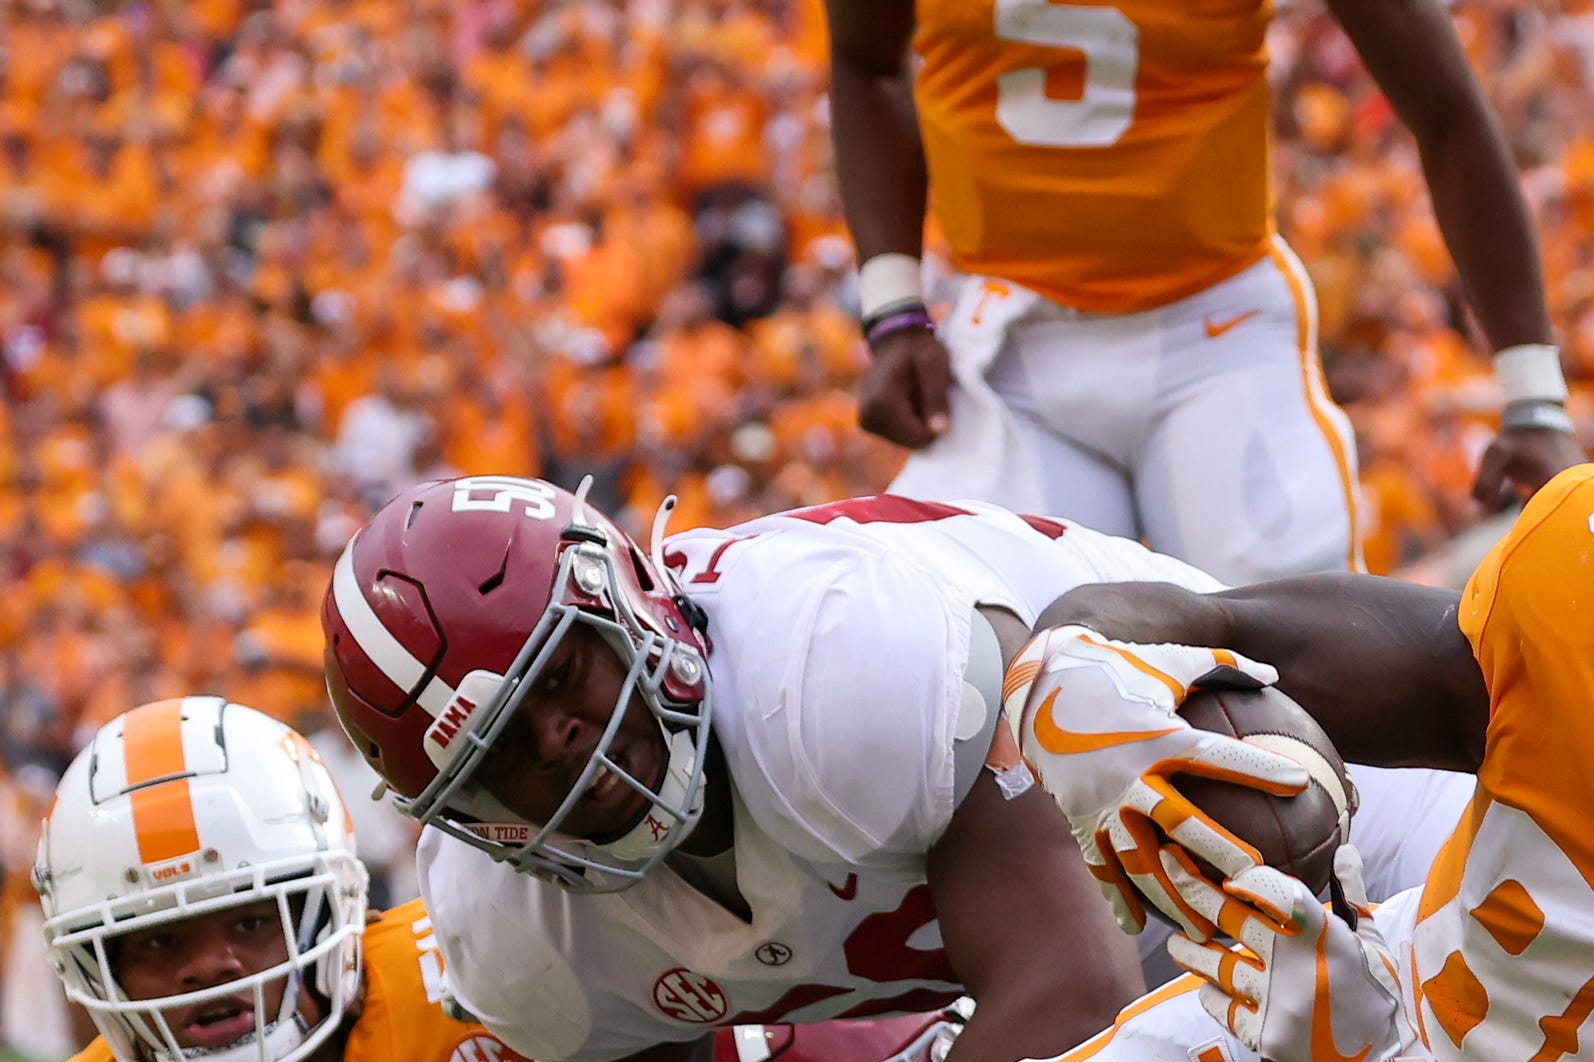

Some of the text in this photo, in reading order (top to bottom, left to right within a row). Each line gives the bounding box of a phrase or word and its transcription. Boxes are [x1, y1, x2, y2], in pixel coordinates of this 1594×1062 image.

[995, 0, 1139, 148] 5
[429, 696, 476, 749] BAMA
[494, 826, 529, 840] TIDE
[152, 861, 191, 881] VOLS
